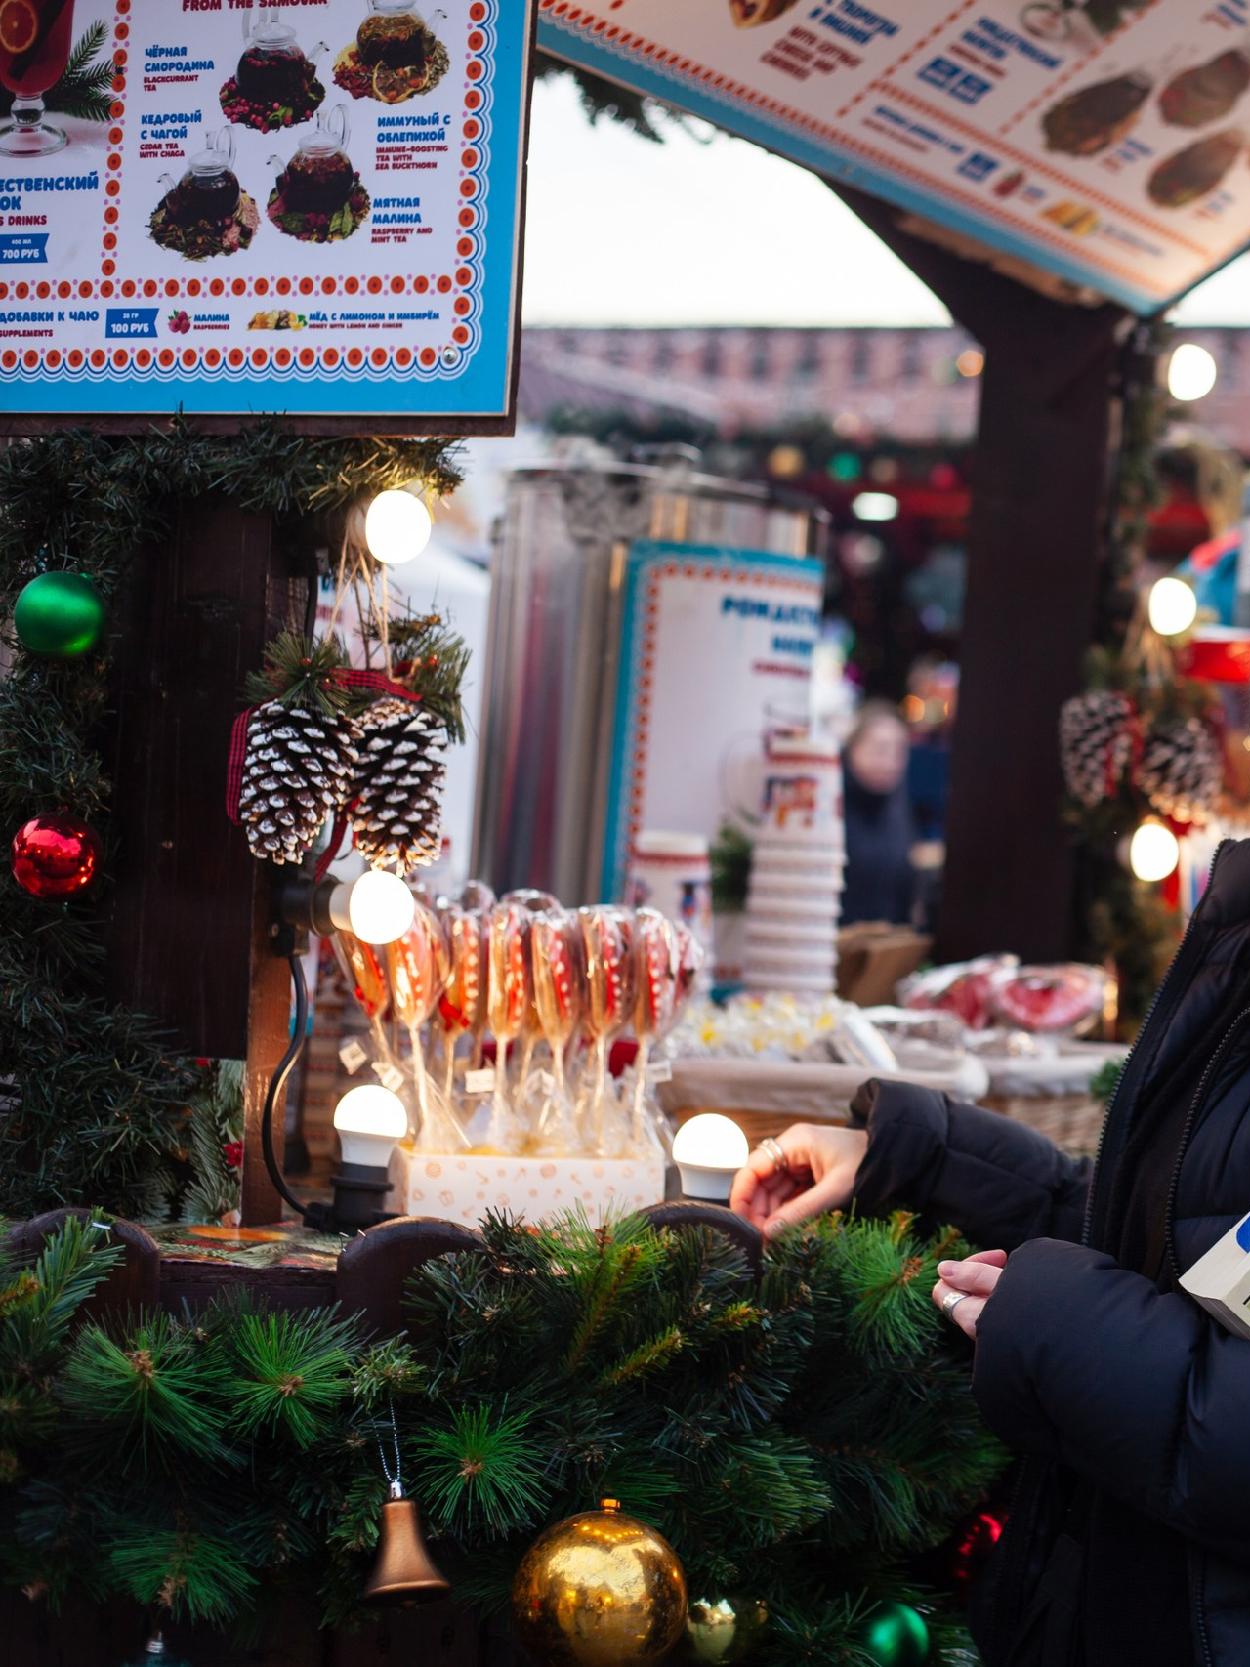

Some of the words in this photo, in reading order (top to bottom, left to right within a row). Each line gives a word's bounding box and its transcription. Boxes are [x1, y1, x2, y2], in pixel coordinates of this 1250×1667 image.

[183, 0, 222, 12] FROM
[228, 0, 253, 9] THE
[145, 45, 188, 58] ЧЁРНАЯ
[144, 60, 215, 72] СМОРОДИНА
[144, 75, 199, 84] BLACKCURRANT
[144, 84, 157, 92] TEA
[141, 110, 202, 126] КЕДРОВЫЙ
[378, 112, 439, 127] ИММУНЫЙ
[443, 114, 451, 125] С
[140, 130, 147, 140] С
[150, 126, 188, 139] ЧАГОЙ
[377, 128, 445, 143] ОБЛЕПИХОЙ
[160, 150, 185, 158] CHAGA
[376, 154, 390, 162] TEA
[392, 154, 412, 162] WITH
[392, 162, 438, 170] BUCKTHORN
[372, 198, 420, 208] МЯТНАЯ
[8, 215, 47, 226] DRINKS
[372, 213, 422, 224] МАЛИНА
[371, 236, 390, 244] MINT
[2, 249, 20, 258] 700
[21, 248, 40, 258] РУБ
[0, 312, 54, 324] ДОБАВКИ
[58, 312, 65, 322] К
[69, 310, 100, 322] ЧАЮ
[194, 314, 230, 322] МАЛИНА
[309, 312, 328, 322] МЁД
[332, 312, 337, 320] С
[340, 312, 386, 320] ЛИМОНОМ
[388, 312, 395, 320] И
[110, 323, 128, 334] 100
[130, 322, 149, 334] РУБ
